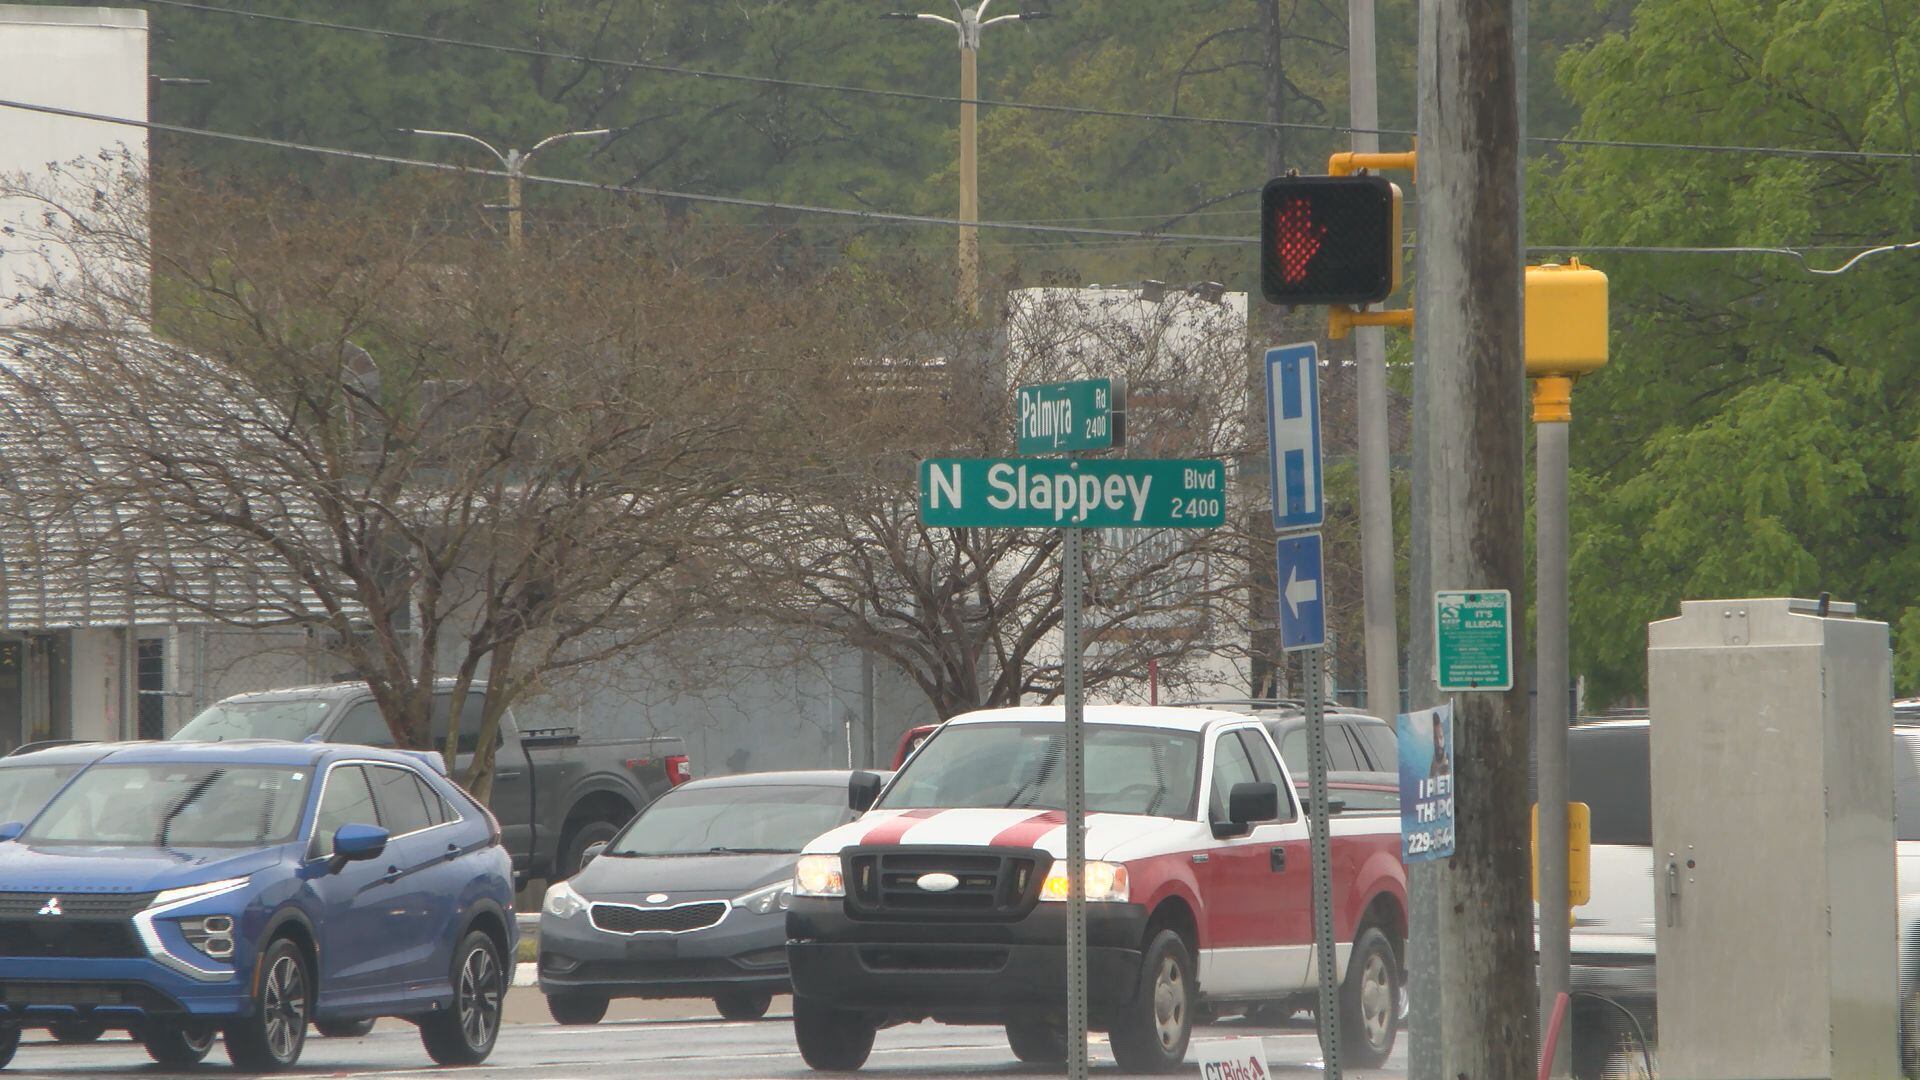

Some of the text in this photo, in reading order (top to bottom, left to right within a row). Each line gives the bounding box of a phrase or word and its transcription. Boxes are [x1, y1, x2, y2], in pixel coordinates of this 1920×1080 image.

[1022, 388, 1106, 448] Palmyra Rd
[1086, 415, 1106, 439] 2400
[1272, 357, 1316, 517] H
[929, 463, 1216, 522] N Slappey Blvd
[1171, 497, 1219, 518] 2400
[1465, 620, 1504, 628] ILLEGAL
